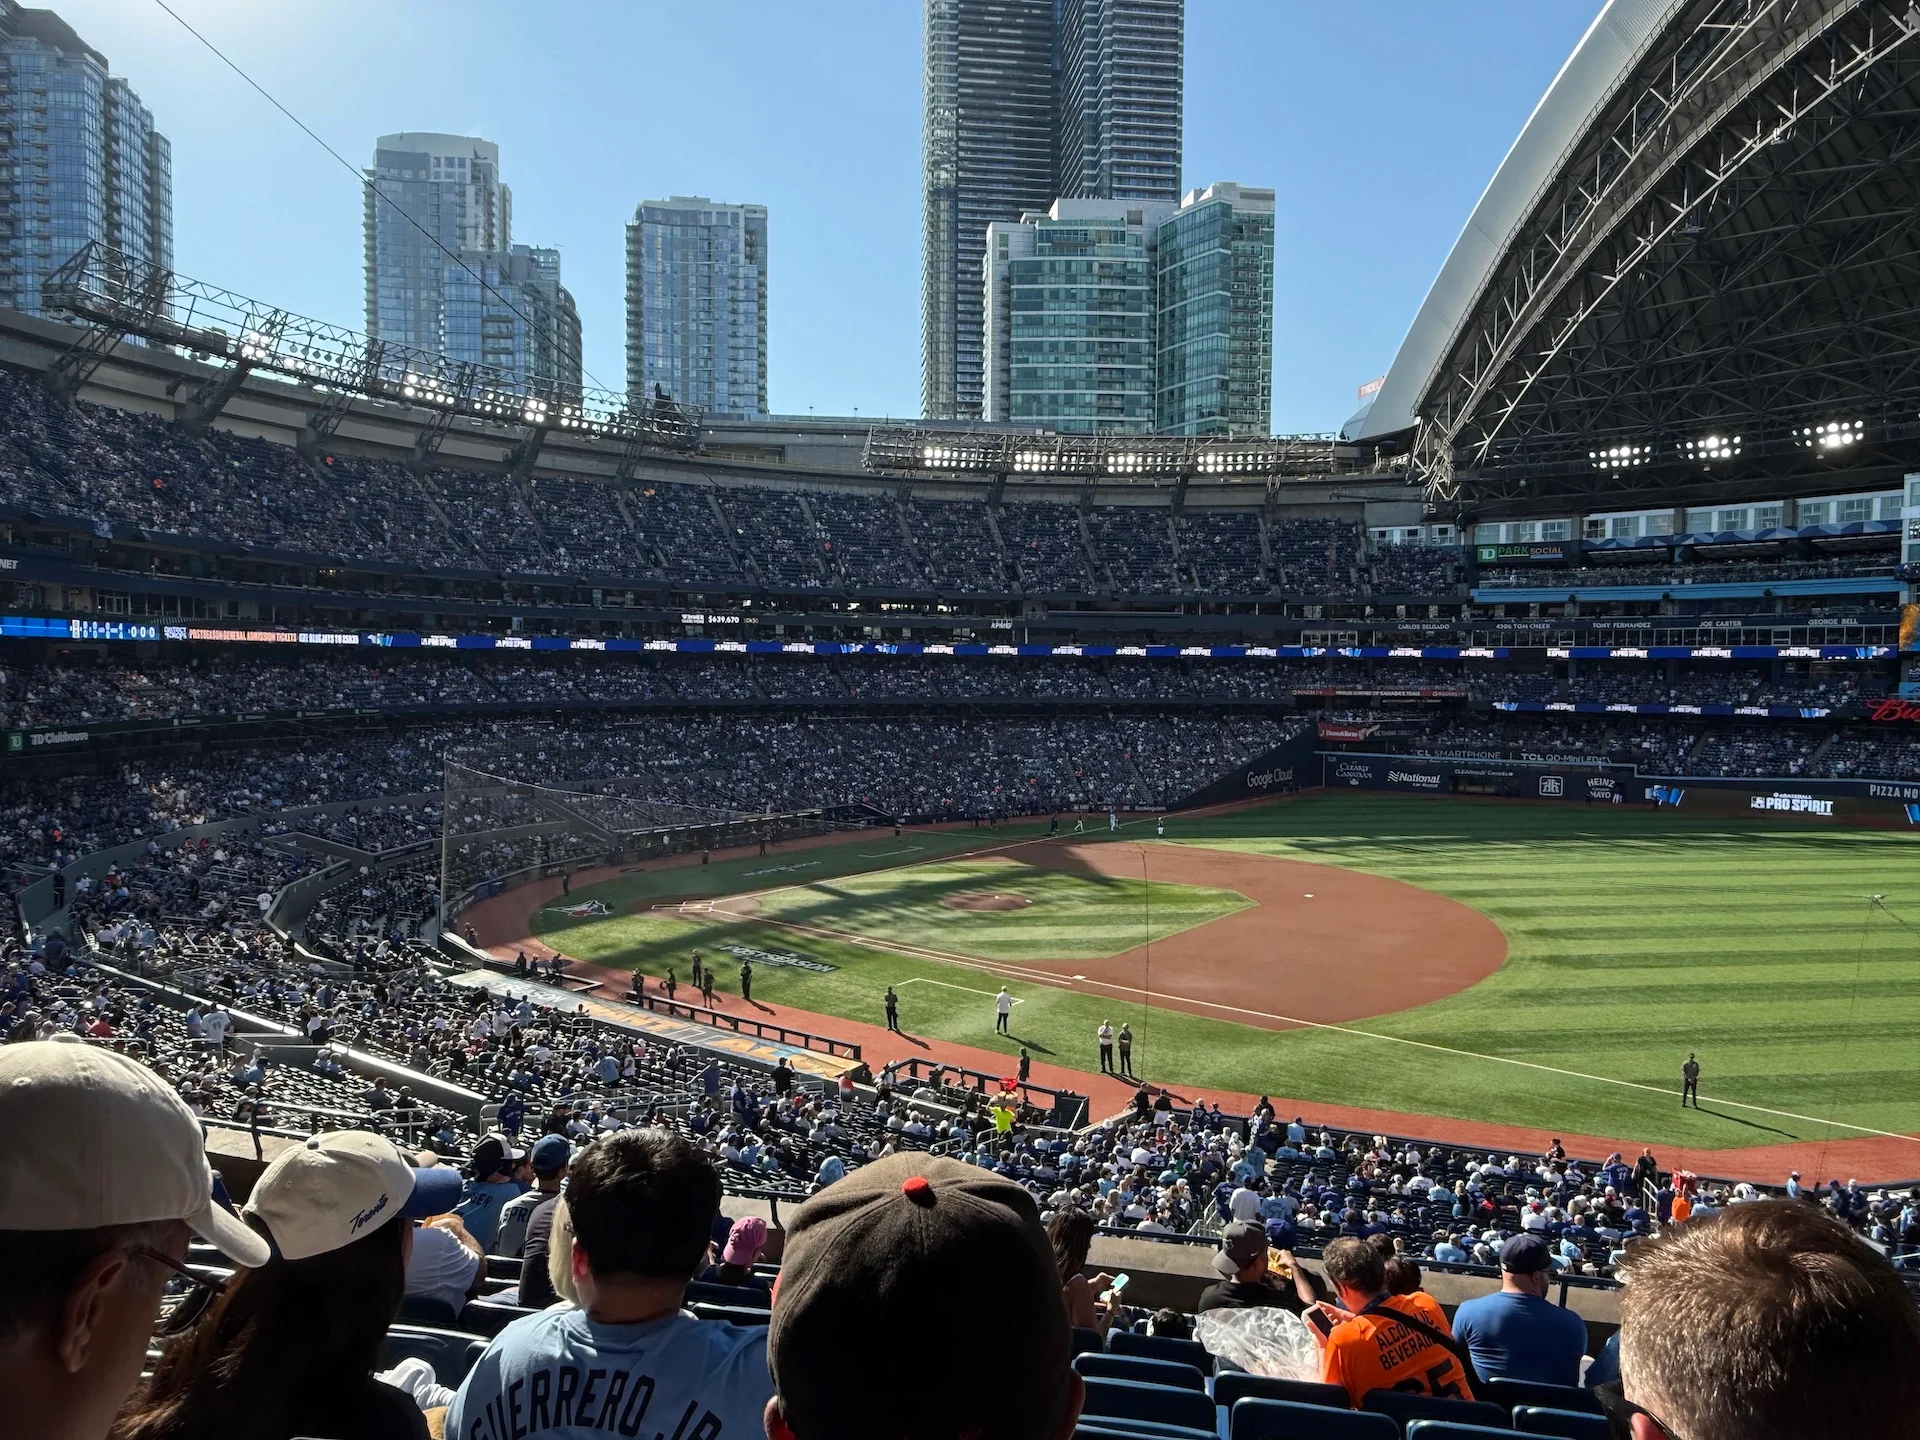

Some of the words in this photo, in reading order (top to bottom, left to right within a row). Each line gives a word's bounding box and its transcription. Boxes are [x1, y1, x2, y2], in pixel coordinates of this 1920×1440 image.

[1480, 548, 1495, 560] TD
[1499, 546, 1528, 555] PARK
[0, 558, 18, 570] NET
[30, 734, 44, 745] TD
[45, 732, 88, 744] Clubhouse
[1435, 750, 1500, 759] SMARTPHONE
[1247, 770, 1273, 788] Google
[1274, 767, 1292, 782] Cloud
[1399, 772, 1440, 784] National
[1587, 778, 1615, 788] HEINZ
[1590, 790, 1611, 798] MAYO
[1870, 784, 1900, 798] PIZZA
[1766, 798, 1790, 810] PRO
[1791, 799, 1833, 812] SPIRIT
[350, 1194, 388, 1234] Toronto
[1375, 1310, 1434, 1351] ALCOIC
[1379, 1326, 1441, 1371] BEVERA
